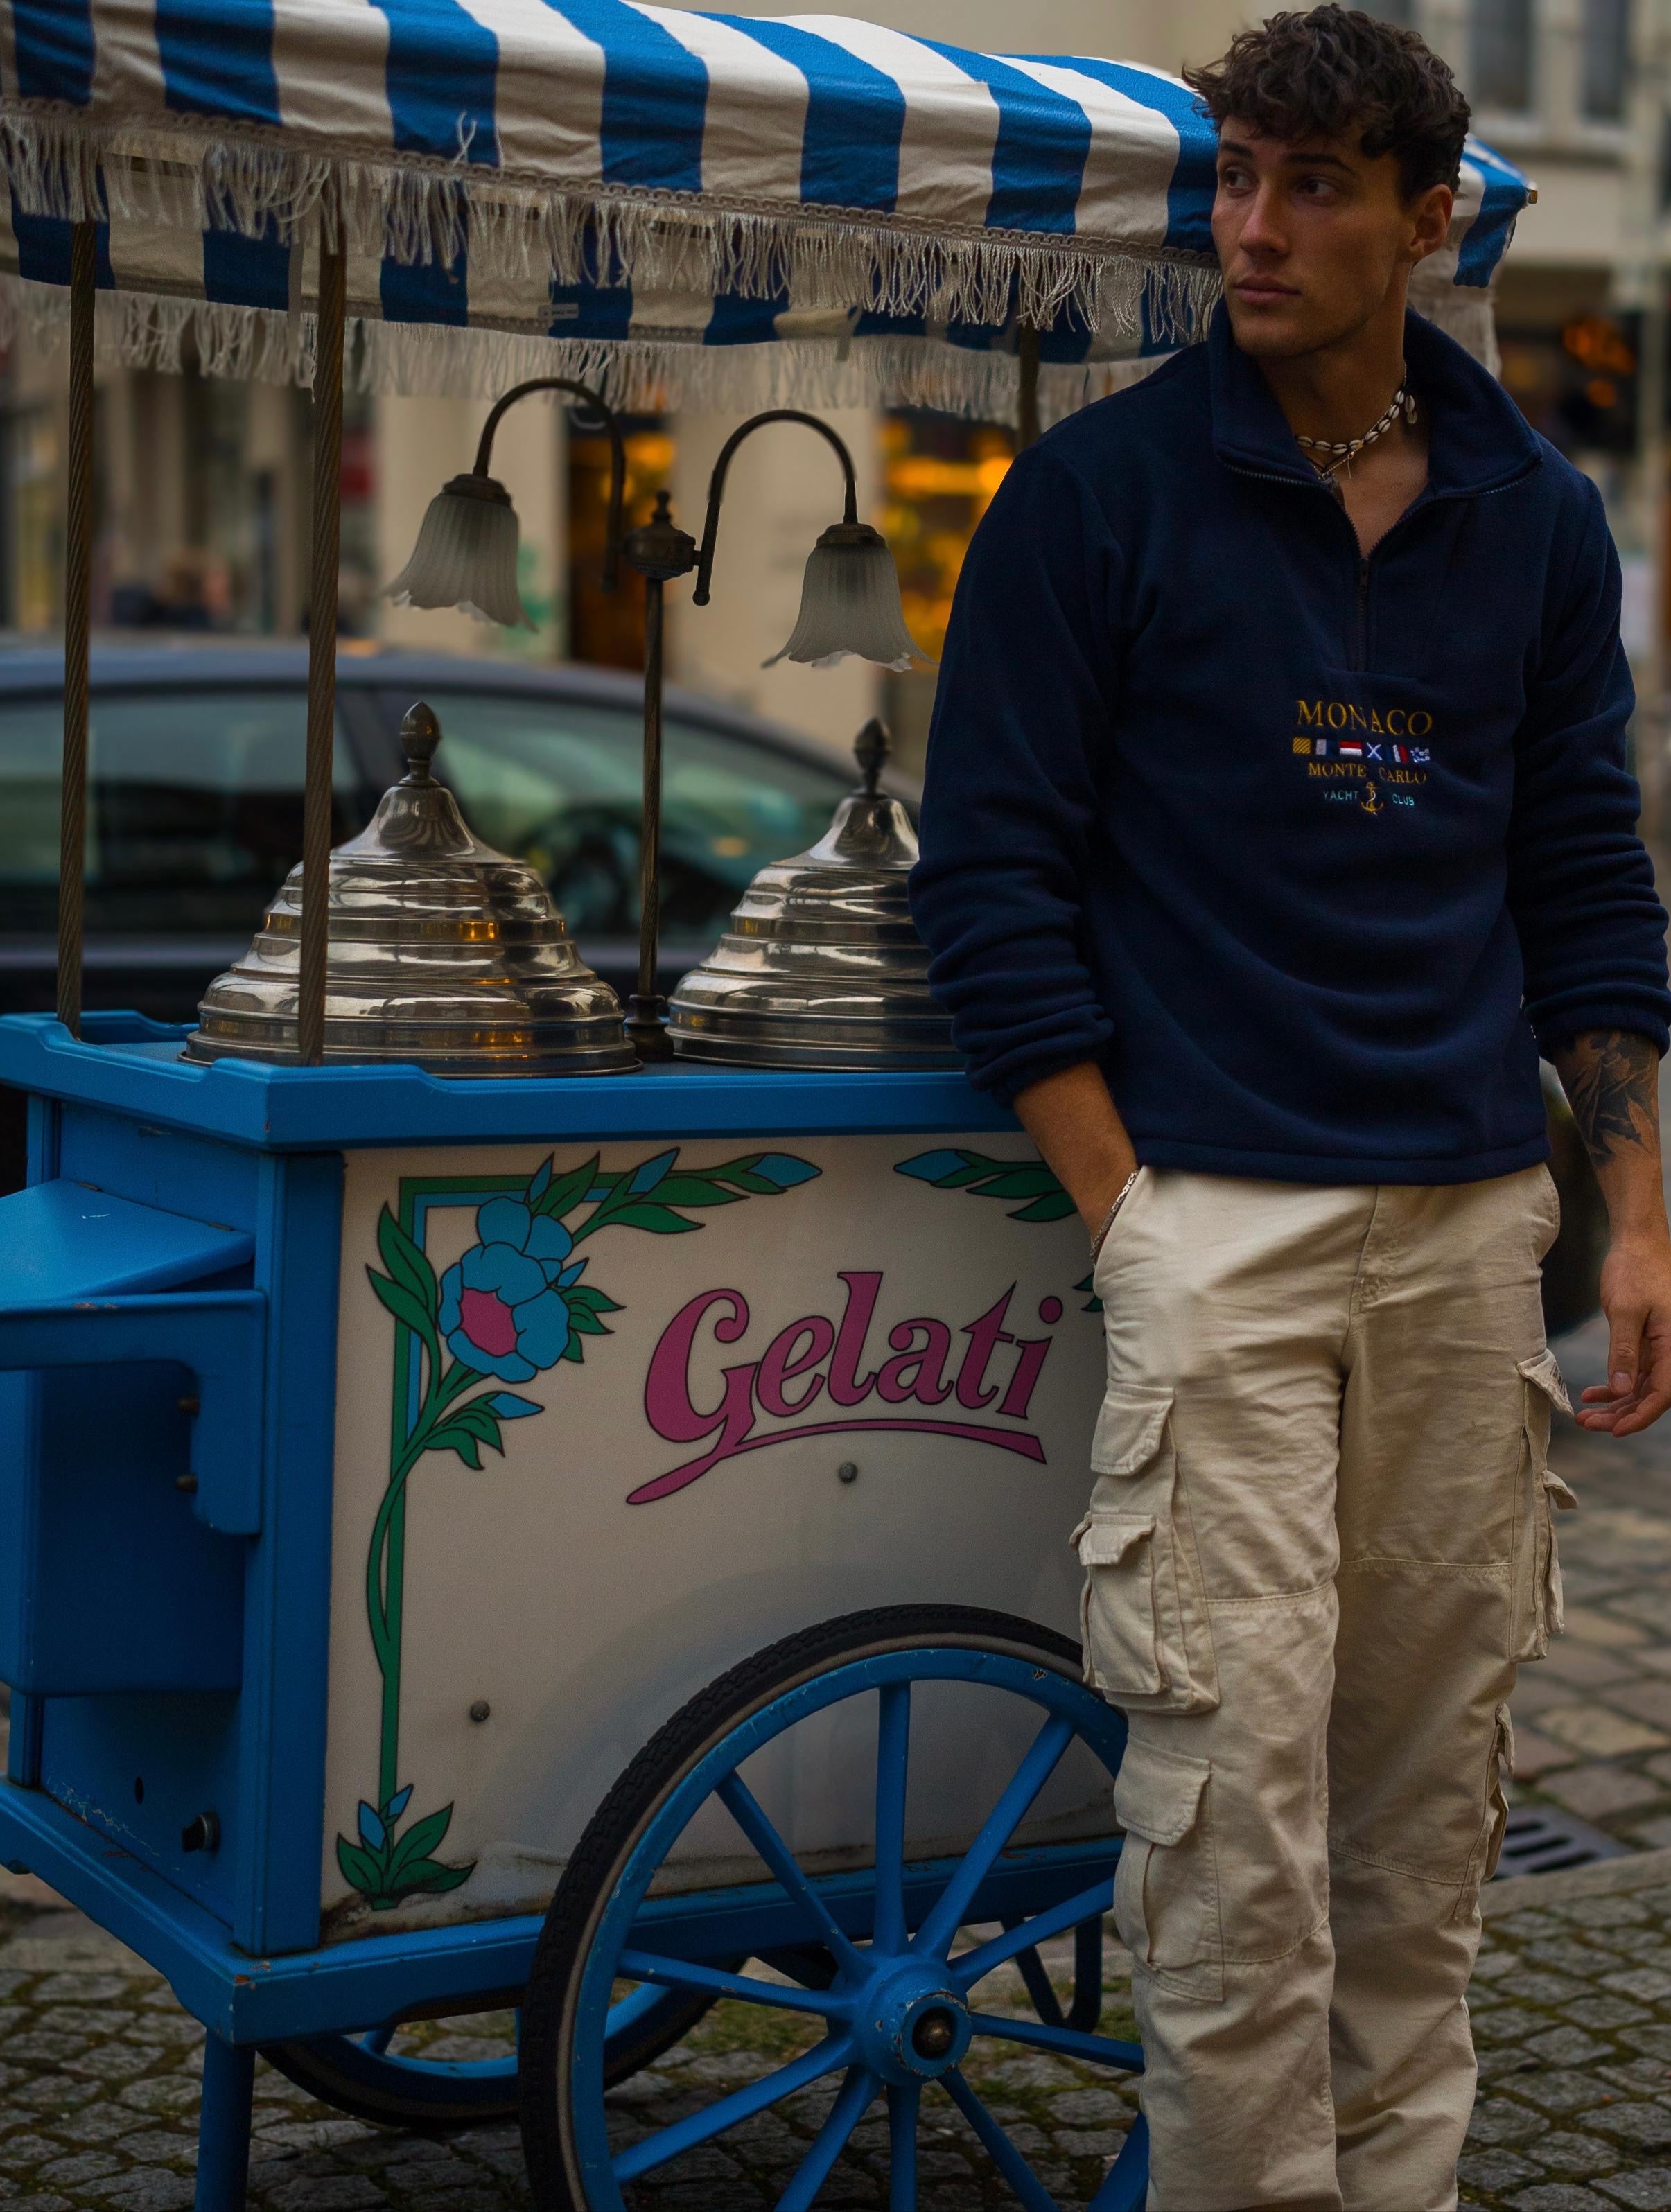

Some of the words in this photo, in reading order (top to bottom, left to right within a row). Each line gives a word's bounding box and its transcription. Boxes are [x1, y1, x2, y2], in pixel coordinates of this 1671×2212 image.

[1295, 699, 1434, 736] MONACO
[1308, 762, 1367, 778] MONTE
[1379, 766, 1428, 784] CARLO
[1324, 790, 1359, 801] YACHT
[1392, 793, 1415, 806] CLUB
[626, 1271, 1064, 1505] Gelati
